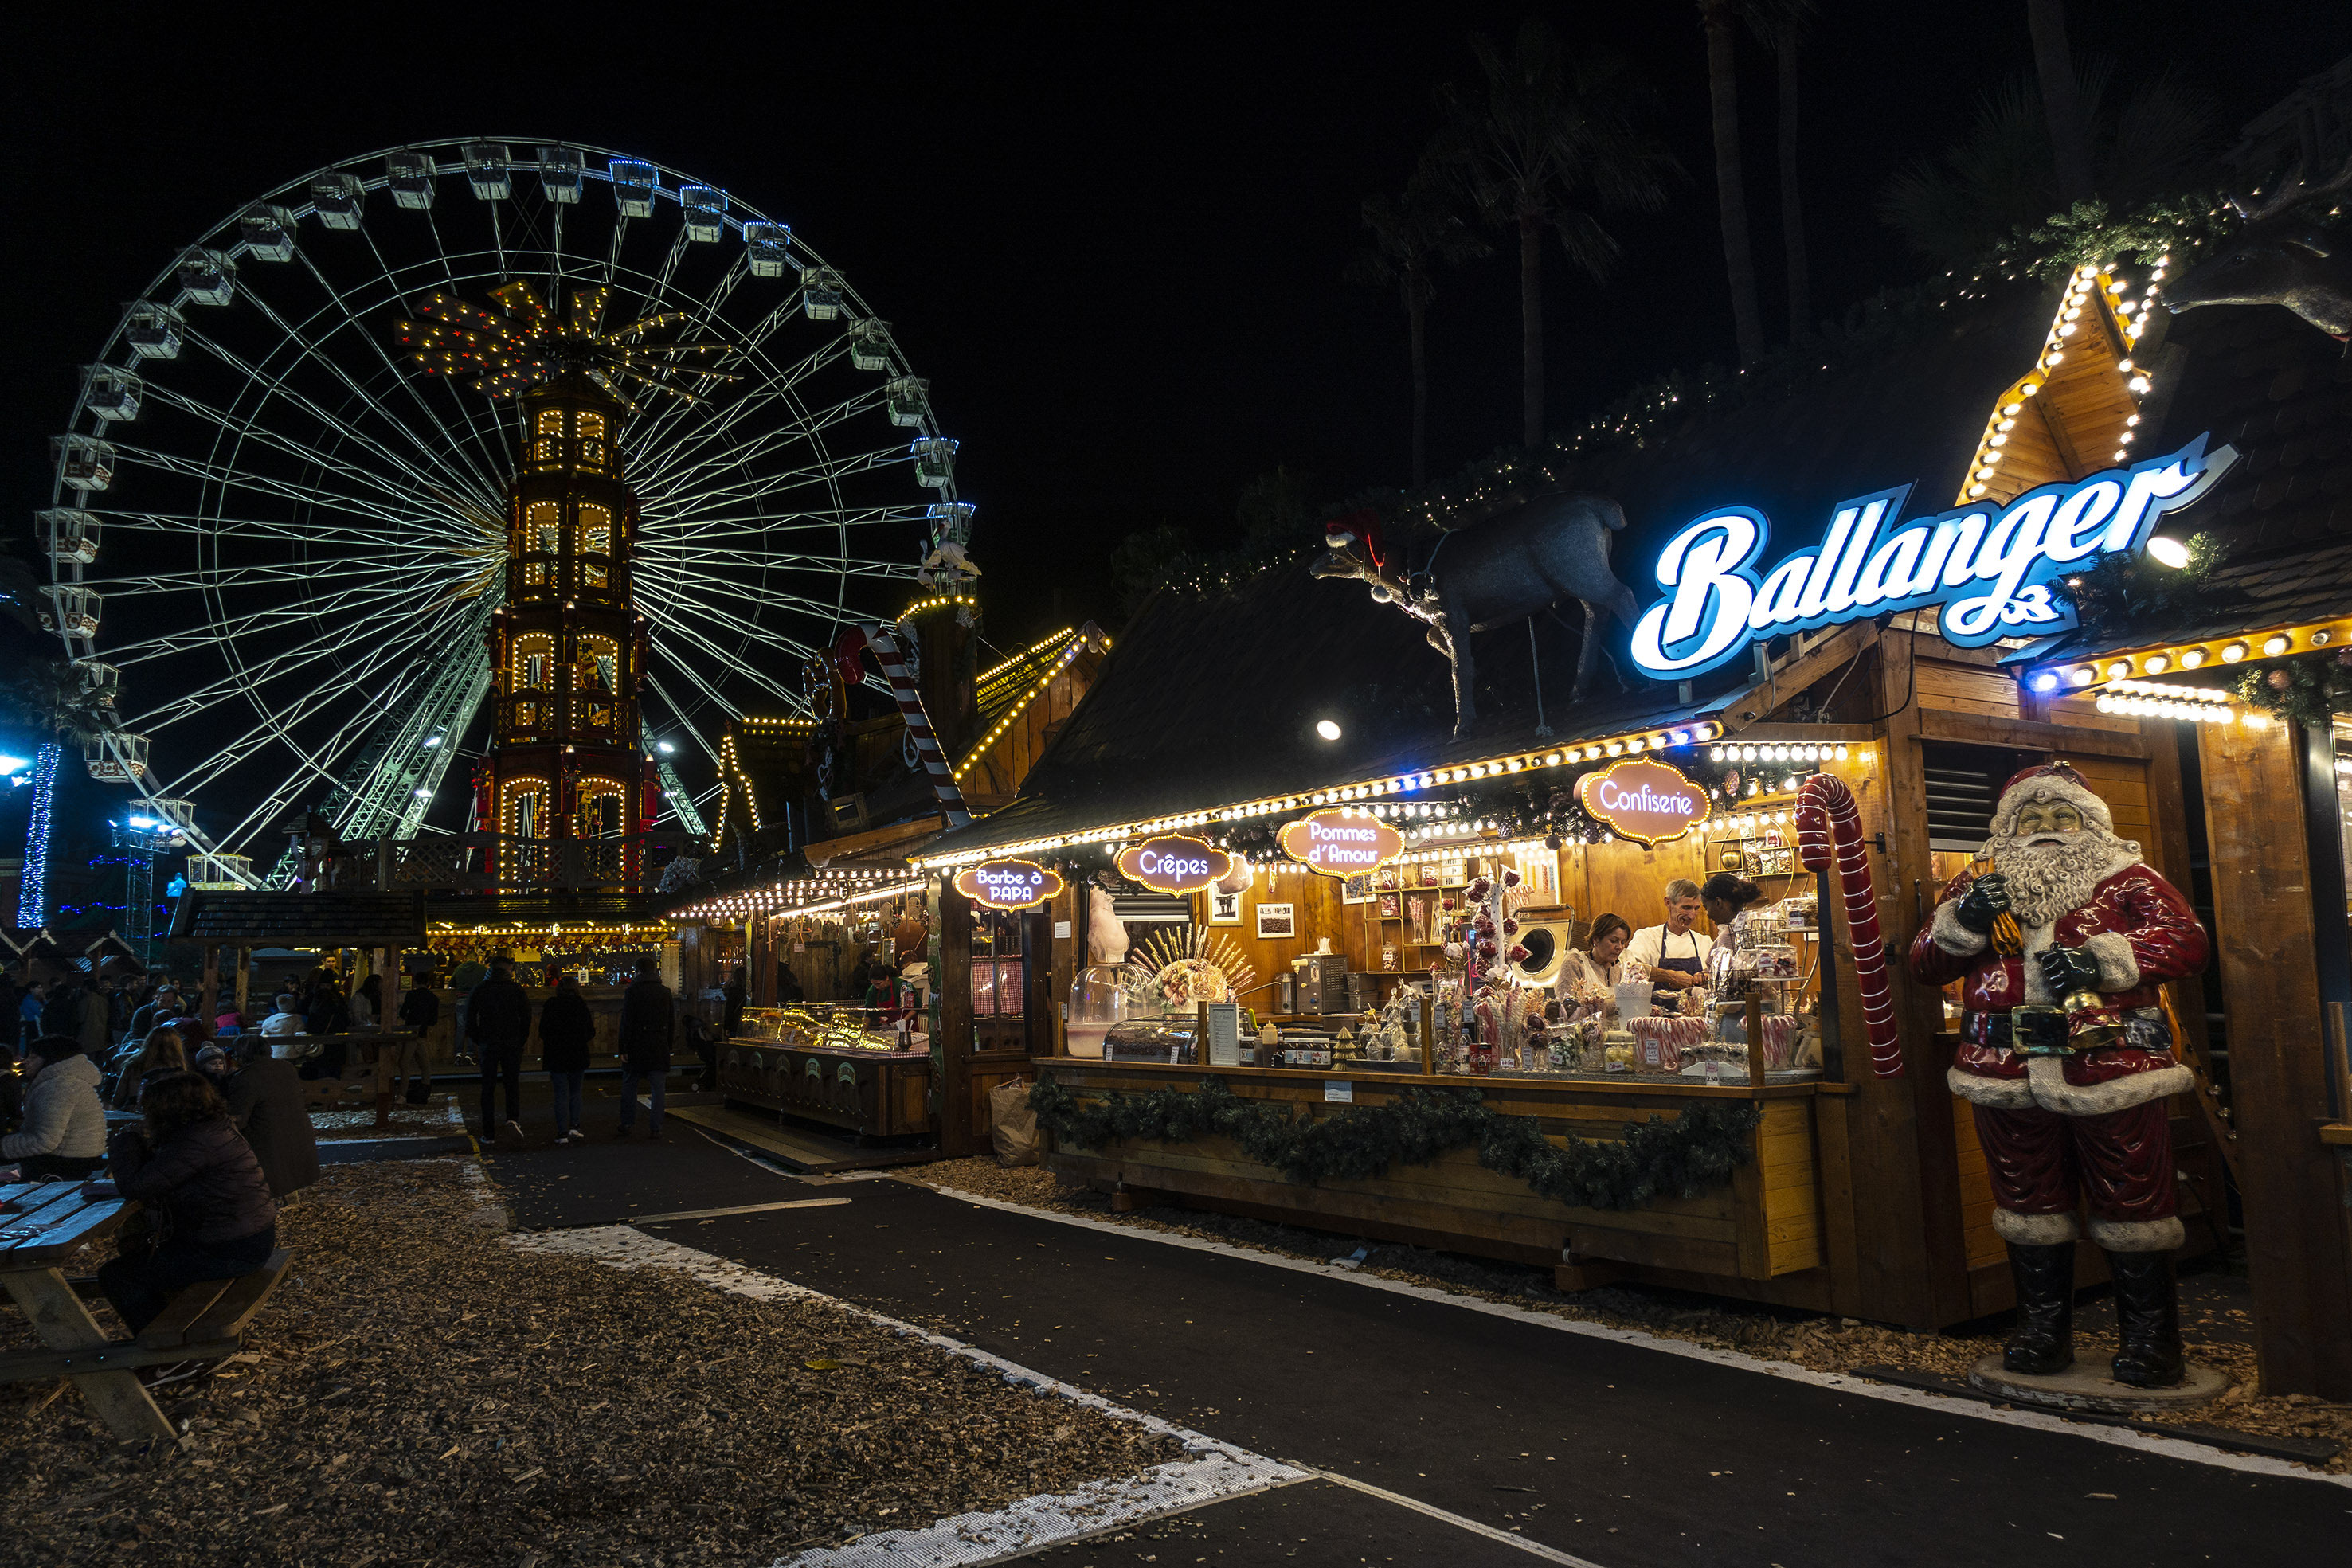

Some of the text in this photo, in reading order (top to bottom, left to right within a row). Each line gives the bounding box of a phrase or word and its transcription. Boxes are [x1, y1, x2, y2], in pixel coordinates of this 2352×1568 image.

[1630, 460, 2200, 671] Ballanger
[1599, 780, 1693, 815] Confiserie
[1309, 821, 1377, 842] Pommes
[1309, 843, 1379, 863] d'Amour
[976, 869, 1043, 885] Barbe à
[1139, 851, 1208, 882] Crêpes
[989, 886, 1032, 901] PAPA
